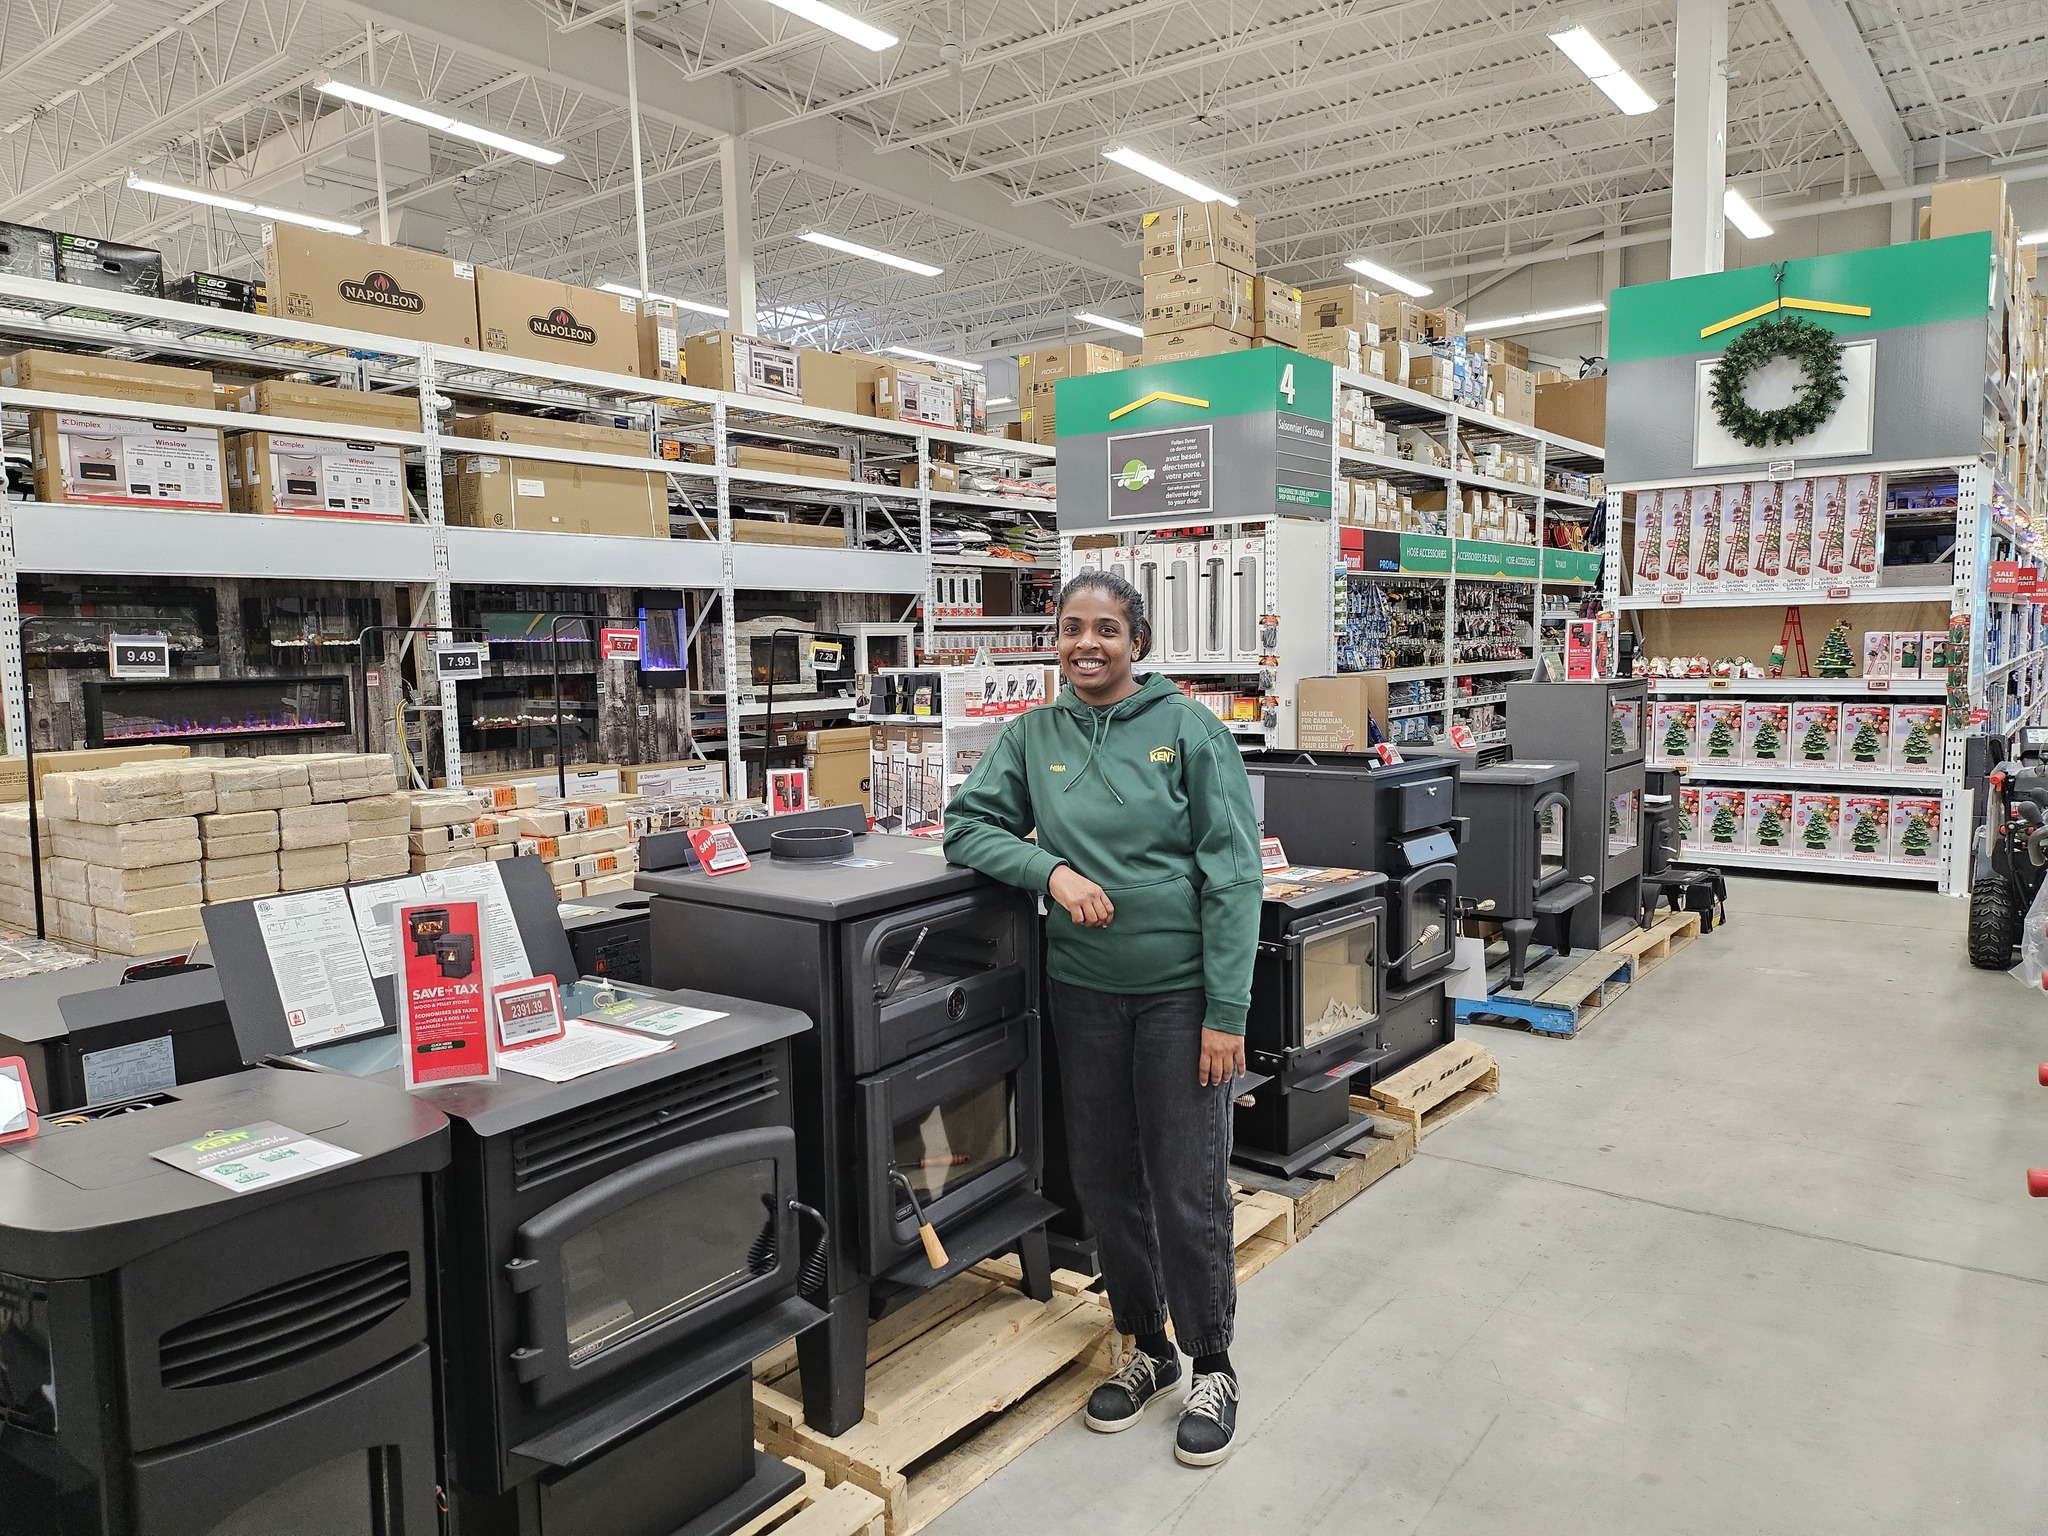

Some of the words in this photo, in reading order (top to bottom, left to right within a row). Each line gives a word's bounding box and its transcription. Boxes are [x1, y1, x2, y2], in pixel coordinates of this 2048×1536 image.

[1157, 223, 1205, 240] FREETYLE
[62, 235, 99, 250] EGO
[197, 277, 228, 289] EGO
[345, 285, 419, 310] NAPOLEON
[1155, 286, 1202, 301] FREESTYLE
[1165, 306, 1173, 314] 10
[532, 320, 593, 342] NAPOLEON
[1154, 349, 1200, 362] FREESTYLE
[1041, 366, 1064, 375] ROGUE
[1280, 363, 1296, 405] 4
[70, 418, 101, 429] Dimplex
[1278, 419, 1302, 434] Saisonnier
[1305, 425, 1325, 439] Seasonal
[155, 439, 187, 448] Winslow
[280, 440, 305, 449] Dimplex
[348, 457, 375, 465] Winslow
[1181, 451, 1202, 460] besoin
[1162, 461, 1200, 471] directement
[1182, 470, 1202, 480] porte.
[1165, 490, 1189, 499] delivered
[1190, 489, 1203, 498] right
[1174, 499, 1186, 507] your
[1406, 547, 1419, 557] HOSE
[1420, 548, 1447, 559] ACCESSORIES
[1457, 551, 1481, 562] ACCESSOIRES
[1506, 555, 1516, 565] HOSE
[1516, 556, 1536, 567] ACCESSORIES
[616, 641, 632, 650] 5.77
[127, 650, 156, 662] 9.49
[447, 656, 471, 667] 7.99
[819, 652, 834, 661] 7.29
[1301, 735, 1328, 743] FABRIQUÉ
[1149, 750, 1176, 763] KENT
[1049, 763, 1067, 772] HIMA
[699, 835, 715, 853] SAVE
[503, 971, 521, 980] DANGER
[412, 986, 445, 1001] SAVE
[453, 983, 480, 995] TAX
[414, 1009, 452, 1019] ÉCONOMISEZ
[511, 1000, 543, 1019] 2391.39
[416, 1022, 441, 1031] GRANULÉS
[192, 1131, 250, 1152] KENT
